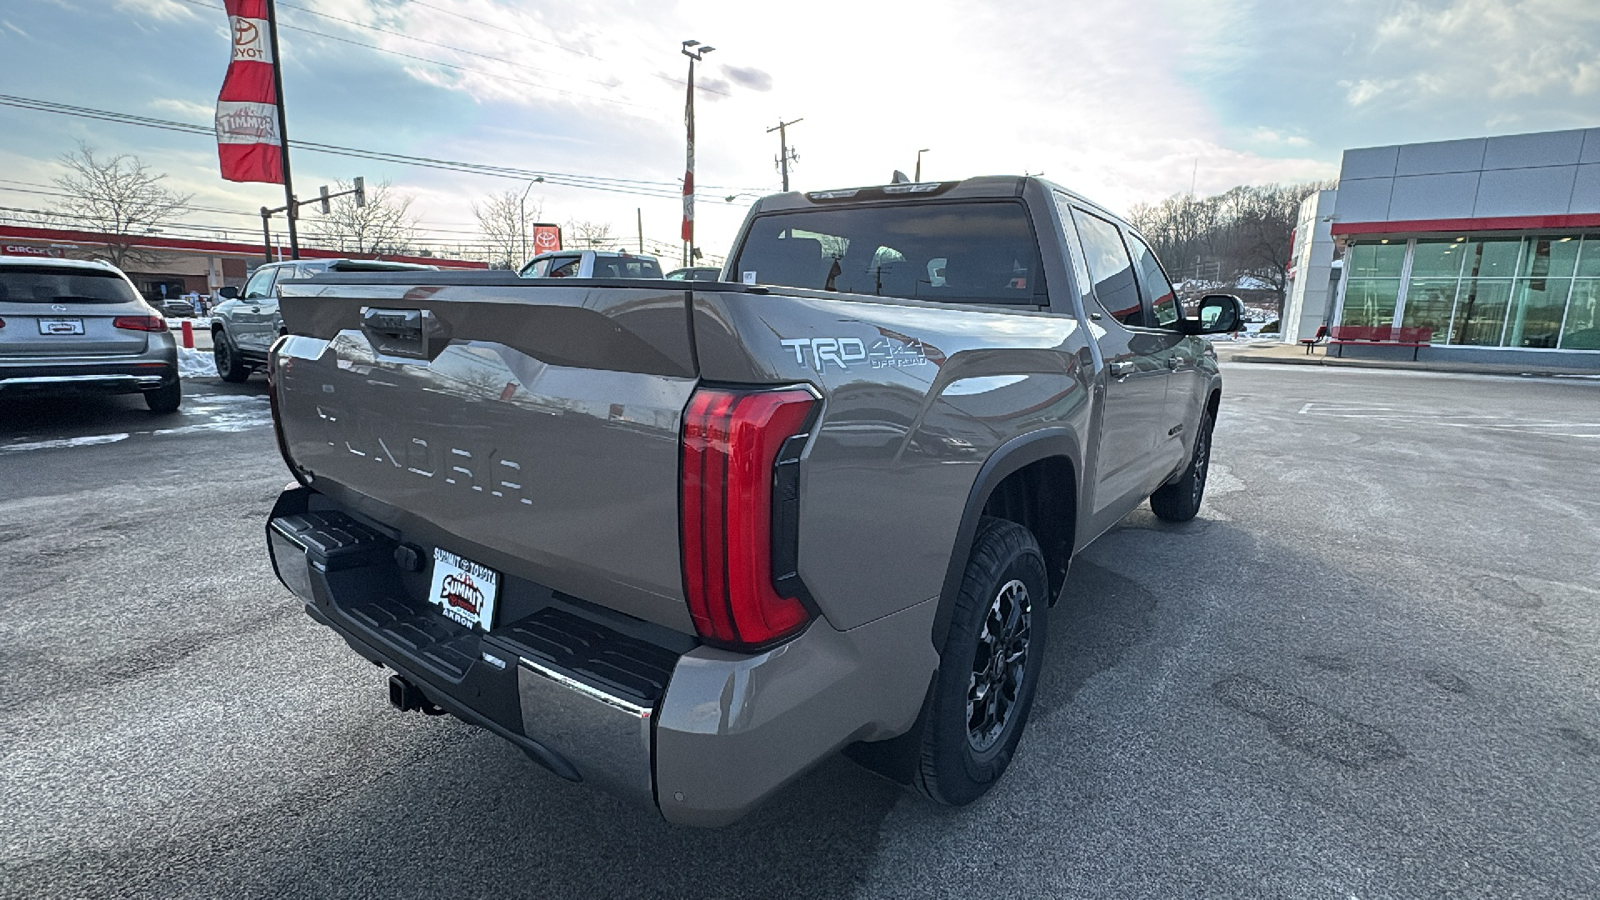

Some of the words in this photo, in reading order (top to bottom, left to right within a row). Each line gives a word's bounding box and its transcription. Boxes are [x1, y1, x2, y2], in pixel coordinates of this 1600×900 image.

[780, 337, 866, 371] TRD
[433, 546, 461, 570] SUMMIT
[469, 562, 497, 586] TOYOTA
[442, 576, 482, 613] SUMMIT
[441, 608, 474, 630] AKRON
